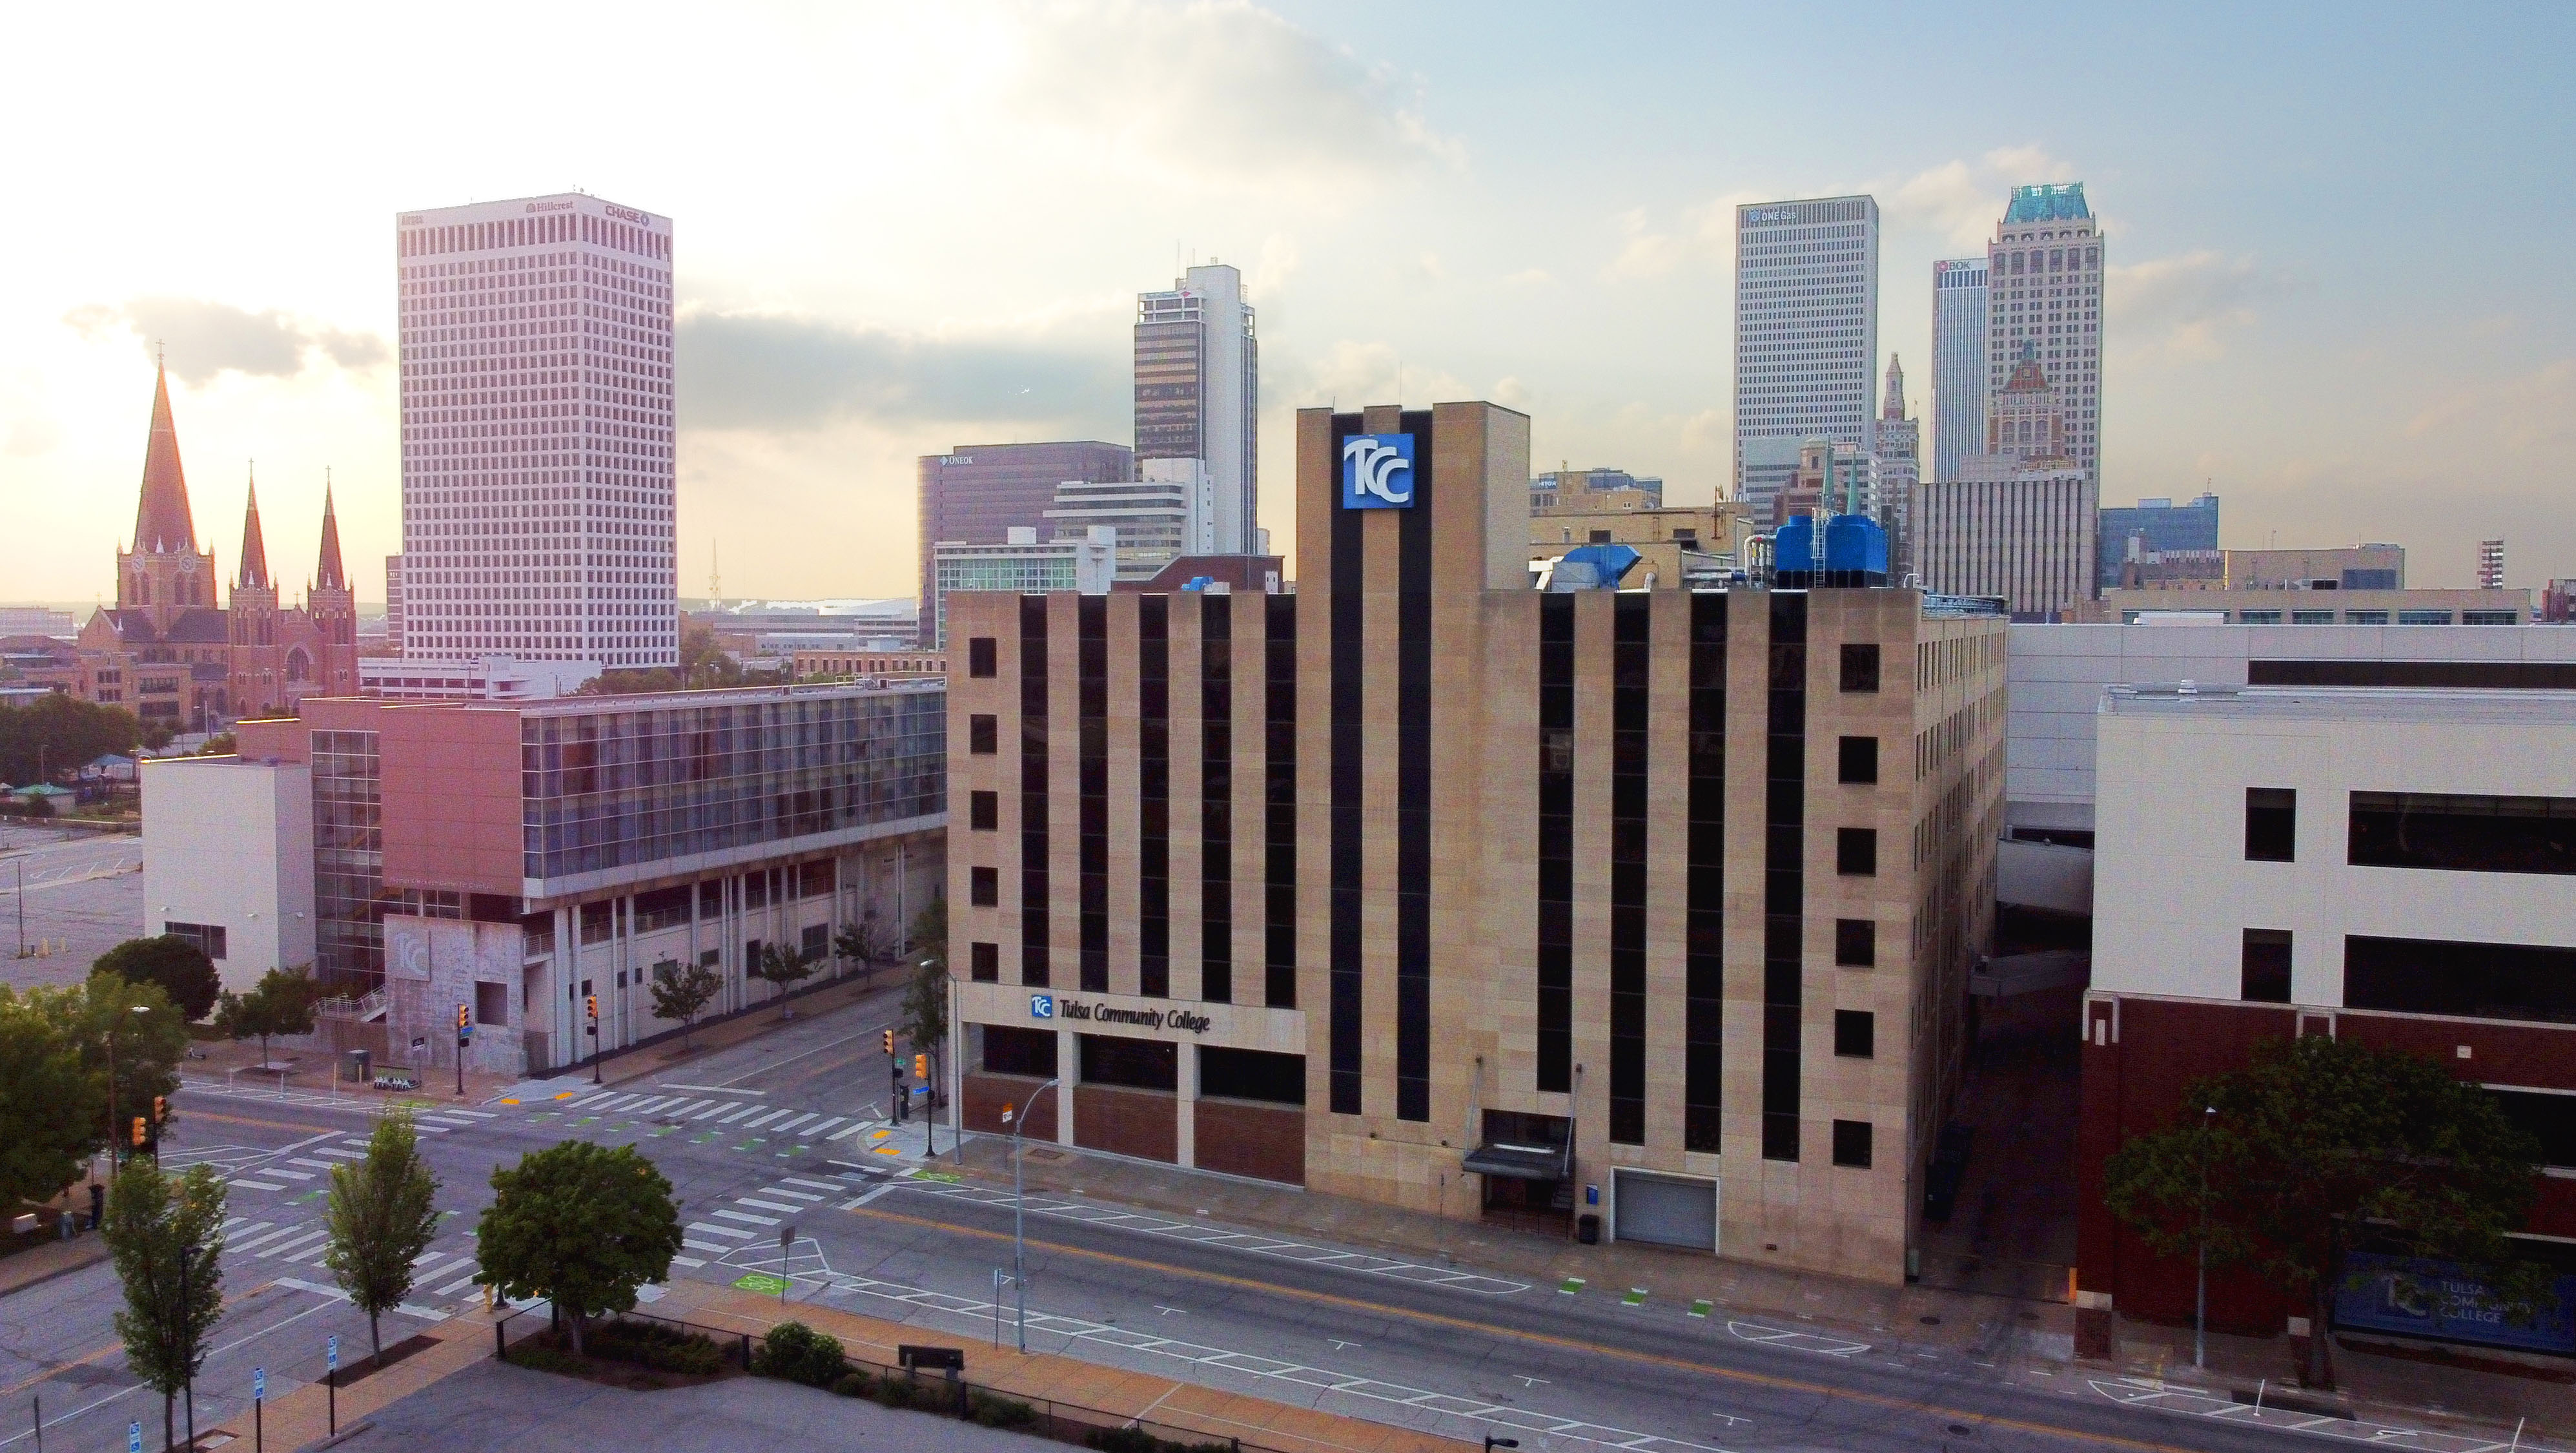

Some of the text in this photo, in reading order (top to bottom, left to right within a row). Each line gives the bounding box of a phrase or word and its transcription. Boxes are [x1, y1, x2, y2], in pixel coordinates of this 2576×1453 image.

[537, 201, 574, 212] Hillcrest
[606, 205, 640, 223] CHASE
[1761, 211, 1796, 221] ONE Gas
[1950, 261, 1970, 270] BOK
[1344, 438, 1409, 503] TCC
[1032, 996, 1210, 1033] TCC Tulsa Community College
[2442, 1281, 2485, 1295] TULSA
[2440, 1307, 2501, 1323] COLLEGE
